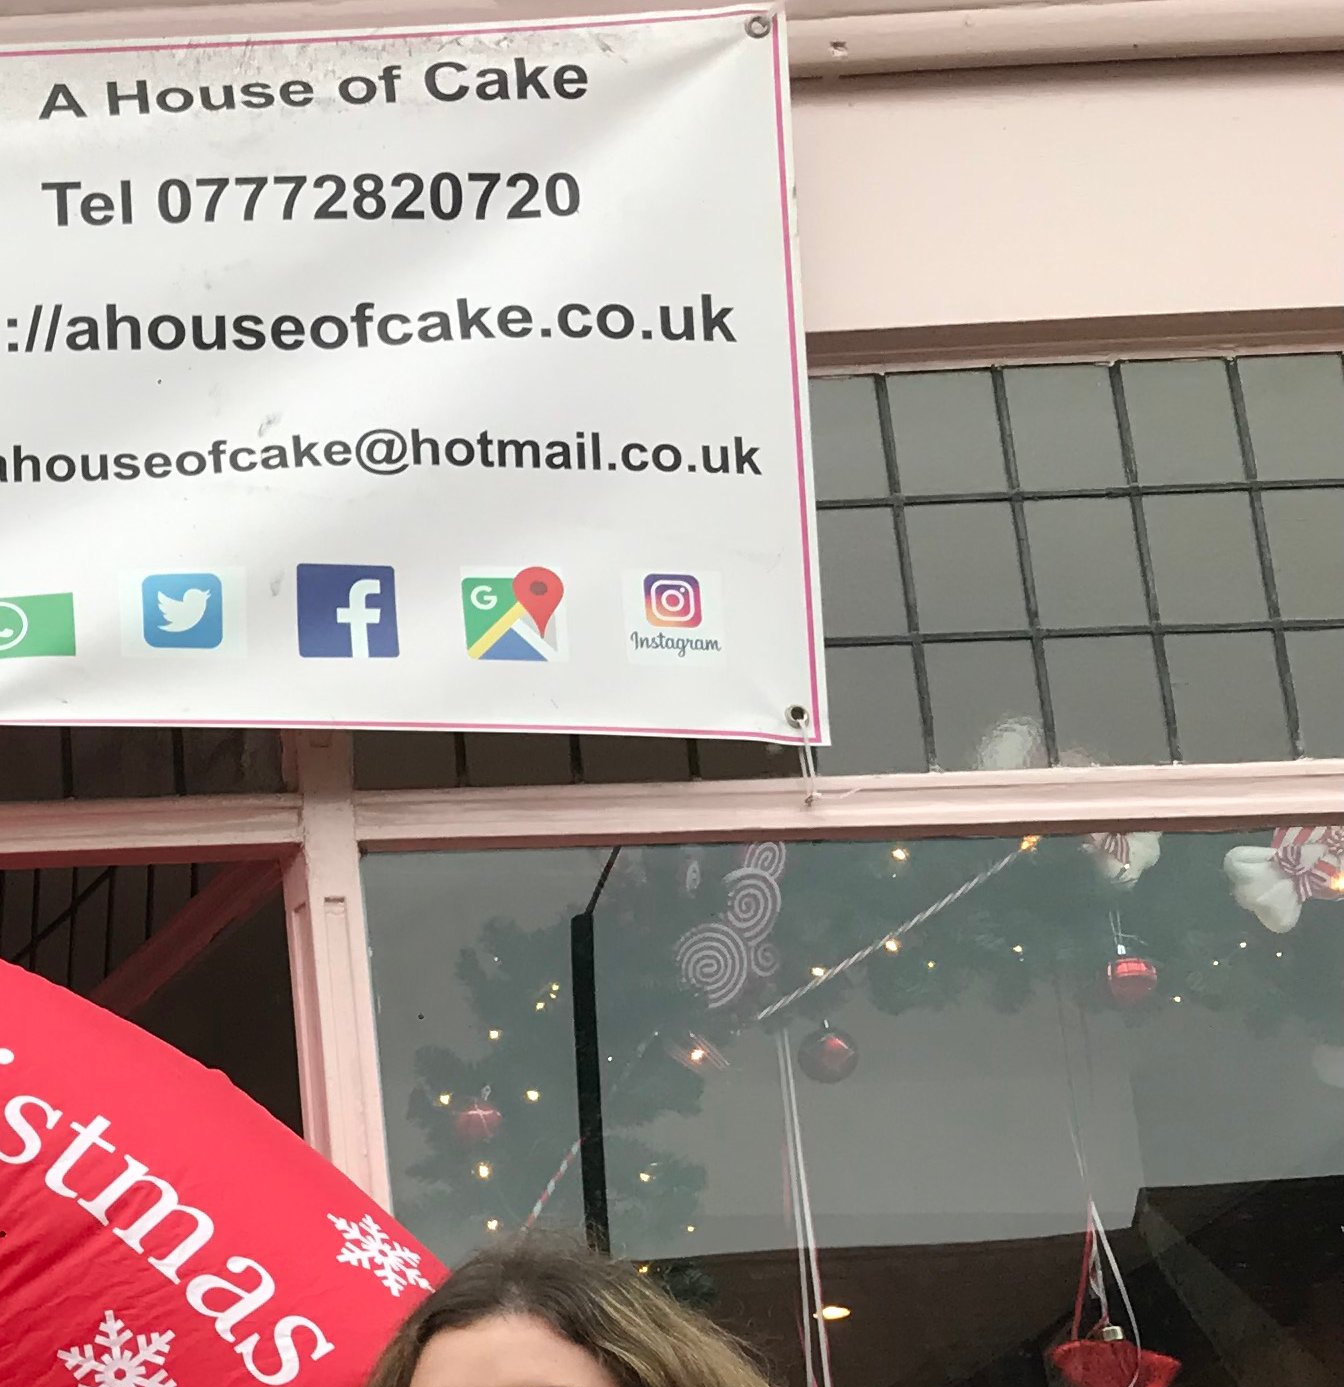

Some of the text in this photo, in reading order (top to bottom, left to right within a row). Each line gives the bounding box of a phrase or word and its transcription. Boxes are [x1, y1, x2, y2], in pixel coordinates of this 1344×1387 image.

[39, 57, 588, 120] A House of Cake
[41, 171, 580, 226] Tel 07772820720
[630, 630, 721, 658] Instagram
